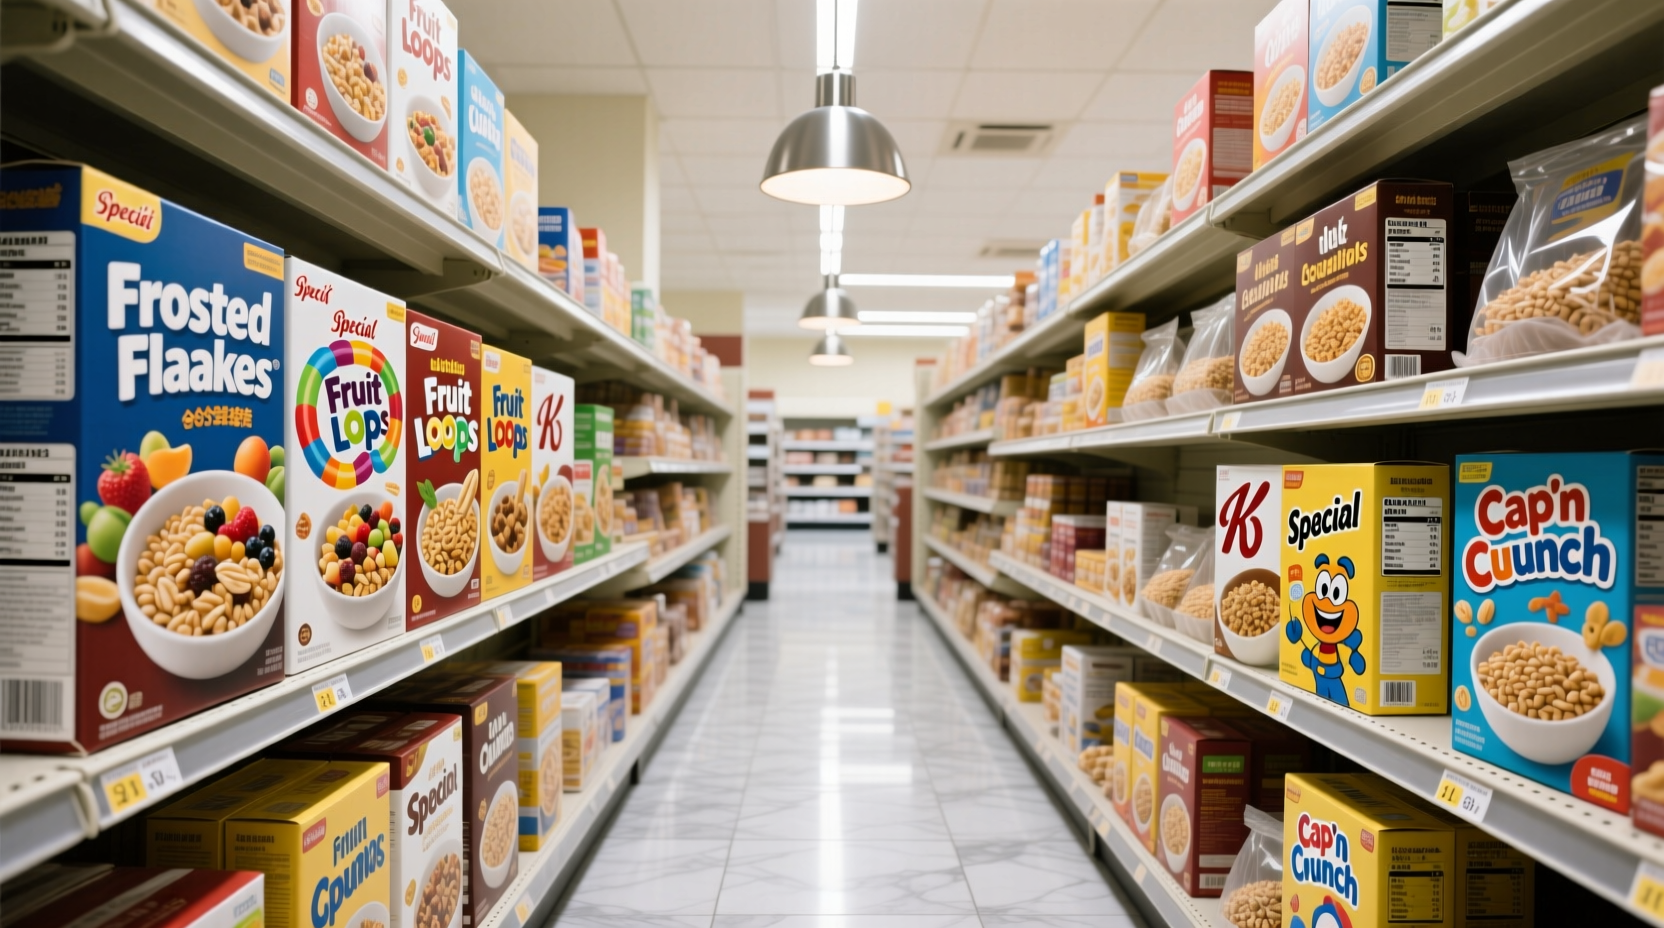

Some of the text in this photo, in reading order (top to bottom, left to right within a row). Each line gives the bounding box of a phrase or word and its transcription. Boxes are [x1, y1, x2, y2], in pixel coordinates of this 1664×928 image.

[409, 0, 441, 44] Fruit
[108, 261, 272, 346] Frosted
[331, 310, 377, 339] Special
[325, 372, 382, 414] Fruit
[424, 377, 472, 415] Fruit
[493, 384, 524, 419] Fruit
[537, 393, 564, 452] K
[1219, 481, 1270, 559] K
[1287, 491, 1361, 550] Special
[1478, 478, 1585, 536] Cap'n
[1466, 526, 1610, 588] Cuunch
[1298, 814, 1348, 863] Cap'n
